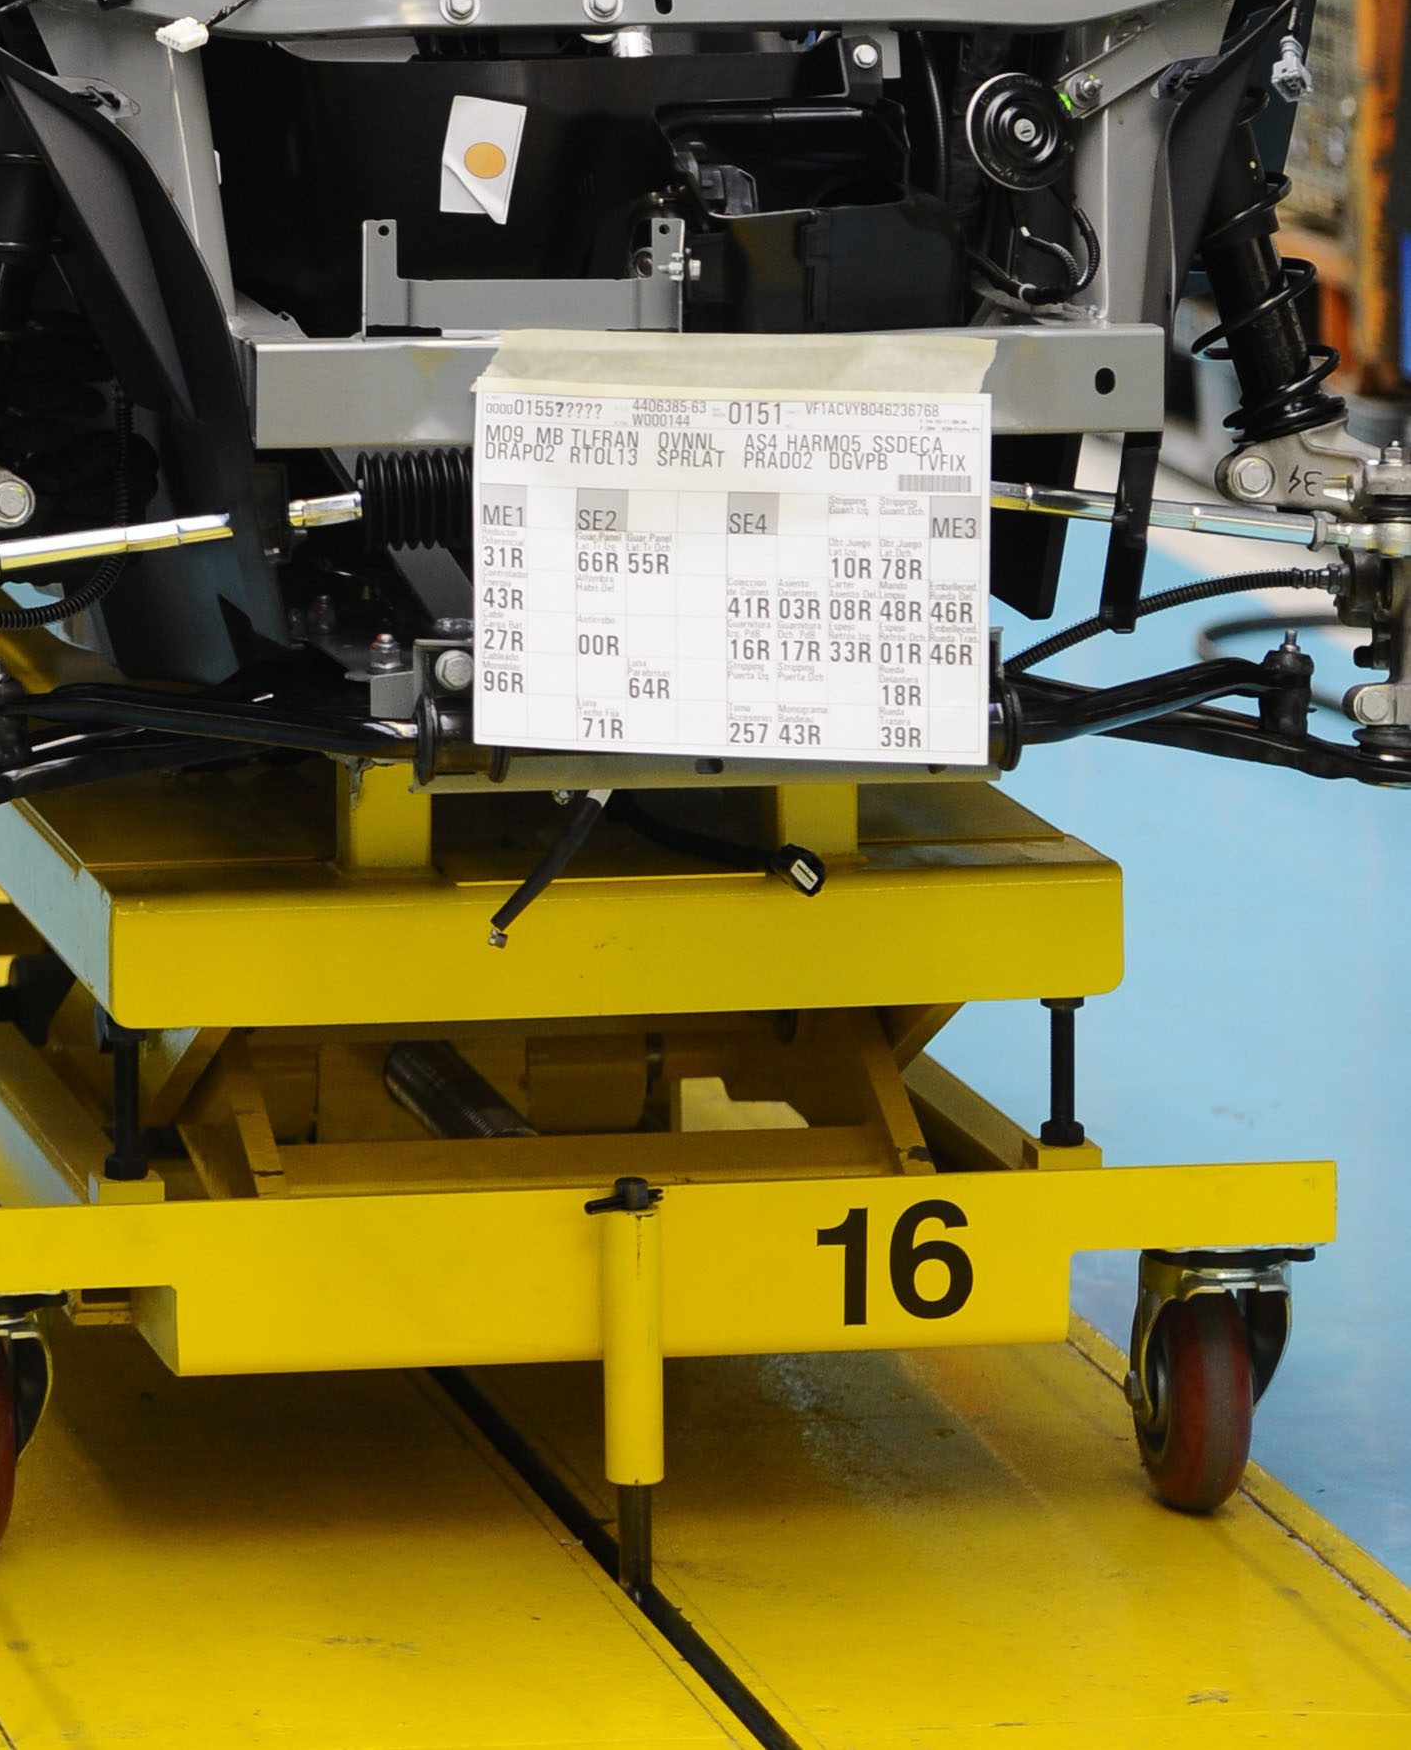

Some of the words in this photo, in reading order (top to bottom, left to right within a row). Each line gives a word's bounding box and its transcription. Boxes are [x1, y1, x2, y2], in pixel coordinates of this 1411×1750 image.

[632, 399, 706, 413] 4406385-63
[729, 401, 781, 425] 0151
[805, 402, 939, 417] VF1ACVYB046236768
[632, 413, 690, 426] W000144
[536, 427, 563, 445] MB
[570, 429, 639, 449] TLFRAN
[744, 434, 777, 451] AS4
[873, 435, 943, 453] SSDECA
[570, 446, 638, 466] RTOL13
[657, 450, 725, 467] SPRLAT
[829, 452, 888, 470] DGVPB
[917, 453, 965, 472] TVFIX
[483, 504, 523, 527] ME1
[578, 509, 617, 531] SE2
[729, 512, 767, 535] SE4
[932, 517, 976, 539] ME3
[484, 546, 523, 568] 31R
[578, 551, 618, 573] 66R
[628, 553, 669, 574] 55R
[831, 557, 871, 579] 10R
[881, 558, 922, 580] 78R
[483, 587, 524, 610] 43R
[728, 597, 770, 619] 41R
[779, 598, 821, 620] 03R
[830, 599, 871, 621] 08R
[880, 600, 922, 622] 48R
[930, 601, 973, 623] 46R
[484, 628, 524, 651] 27R
[579, 634, 619, 656] 00R
[731, 638, 770, 660] 16R
[781, 639, 821, 661] 17R
[830, 641, 871, 663] 33R
[880, 642, 922, 664] 01R
[930, 643, 973, 665] 46R
[484, 670, 524, 693] 96R
[629, 677, 670, 699] 64R
[882, 684, 922, 706] 18R
[582, 717, 623, 739] 71R
[729, 722, 768, 744] 257
[779, 724, 821, 745] 43R
[880, 726, 922, 748] 39R
[817, 1200, 973, 1325] 16
